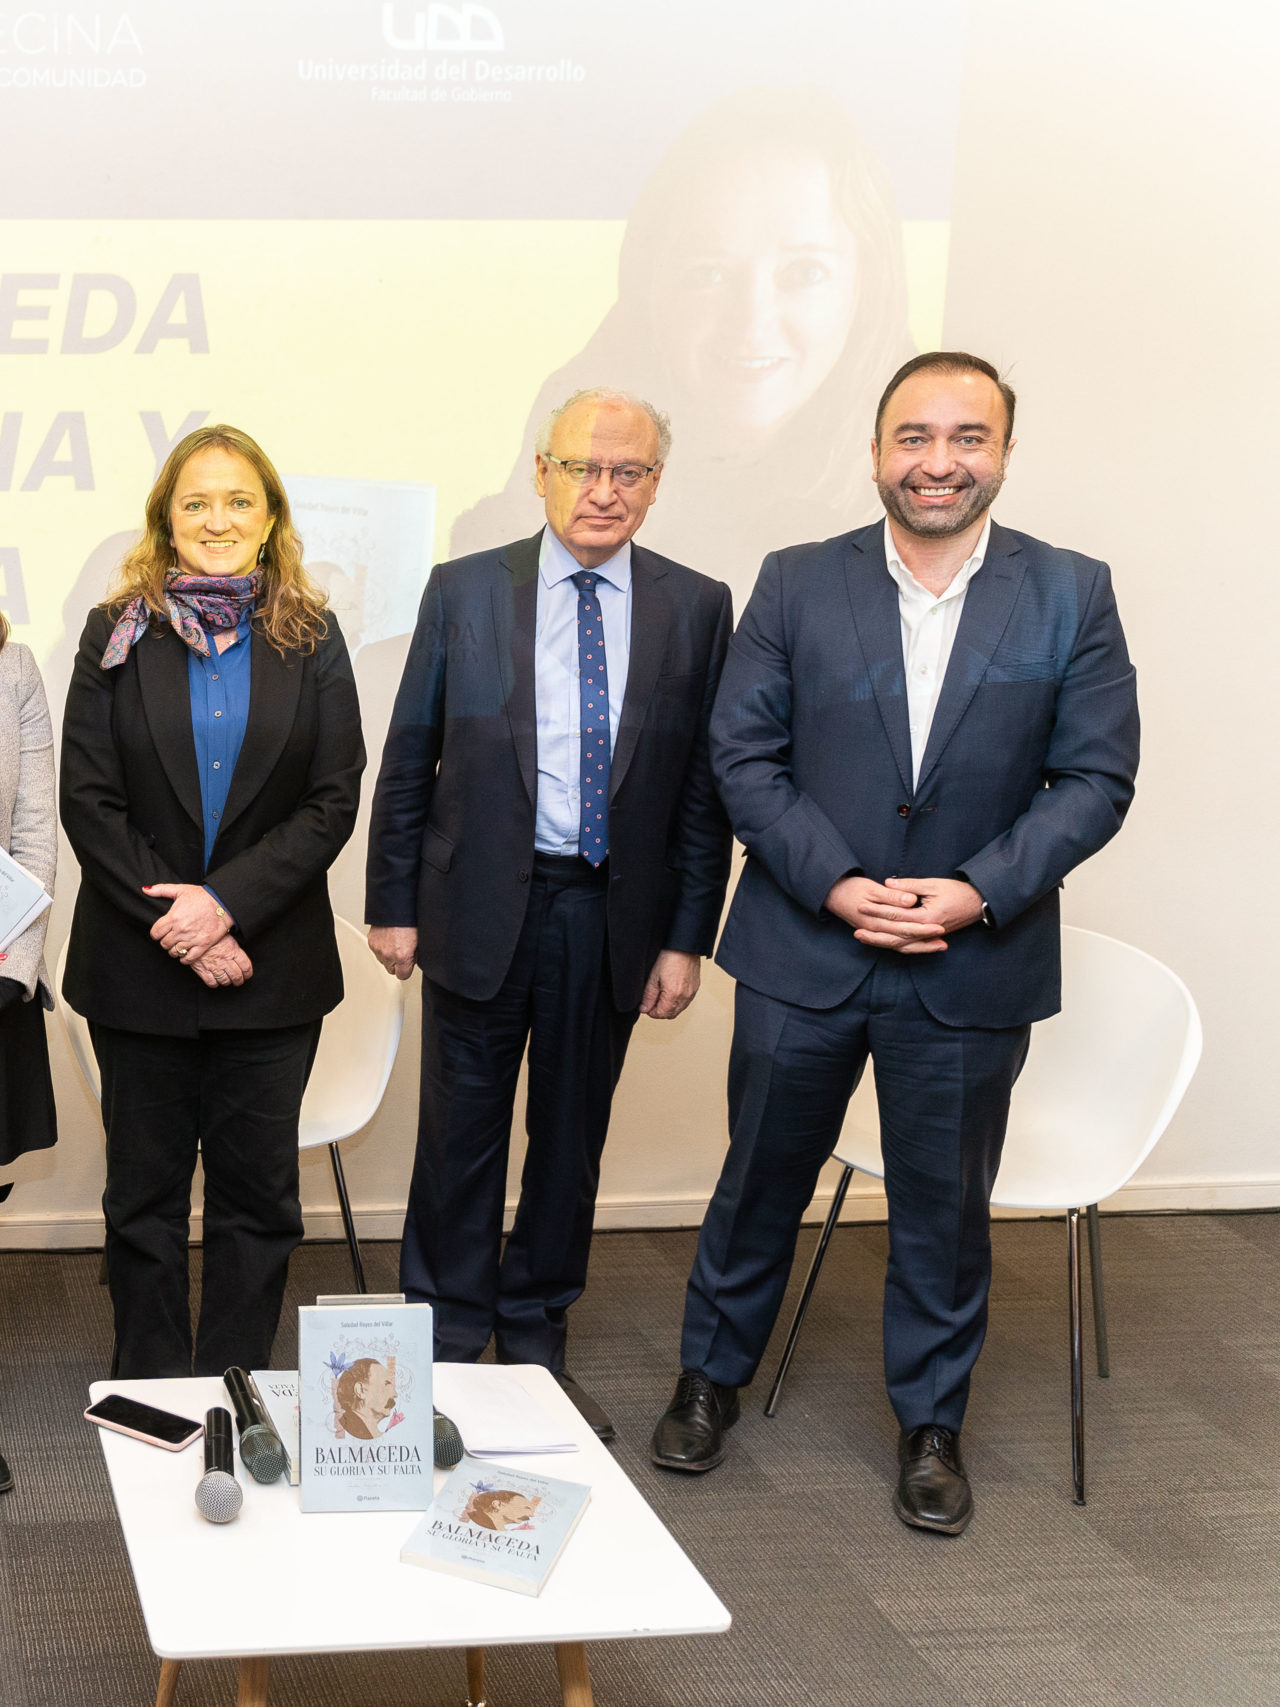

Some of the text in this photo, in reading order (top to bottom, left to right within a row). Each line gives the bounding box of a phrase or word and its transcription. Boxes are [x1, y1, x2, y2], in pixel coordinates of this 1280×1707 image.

[297, 57, 586, 82] Universidad del Desarrollo
[371, 86, 513, 102] Facultad de Gobierno
[315, 1445, 422, 1464] BALMACEDA
[314, 1464, 422, 1476] SU GLORIA Y SU FALTA
[432, 1520, 540, 1555] BALMACEDA
[442, 1533, 479, 1548] GLORIA
[507, 1548, 538, 1561] FALTA
